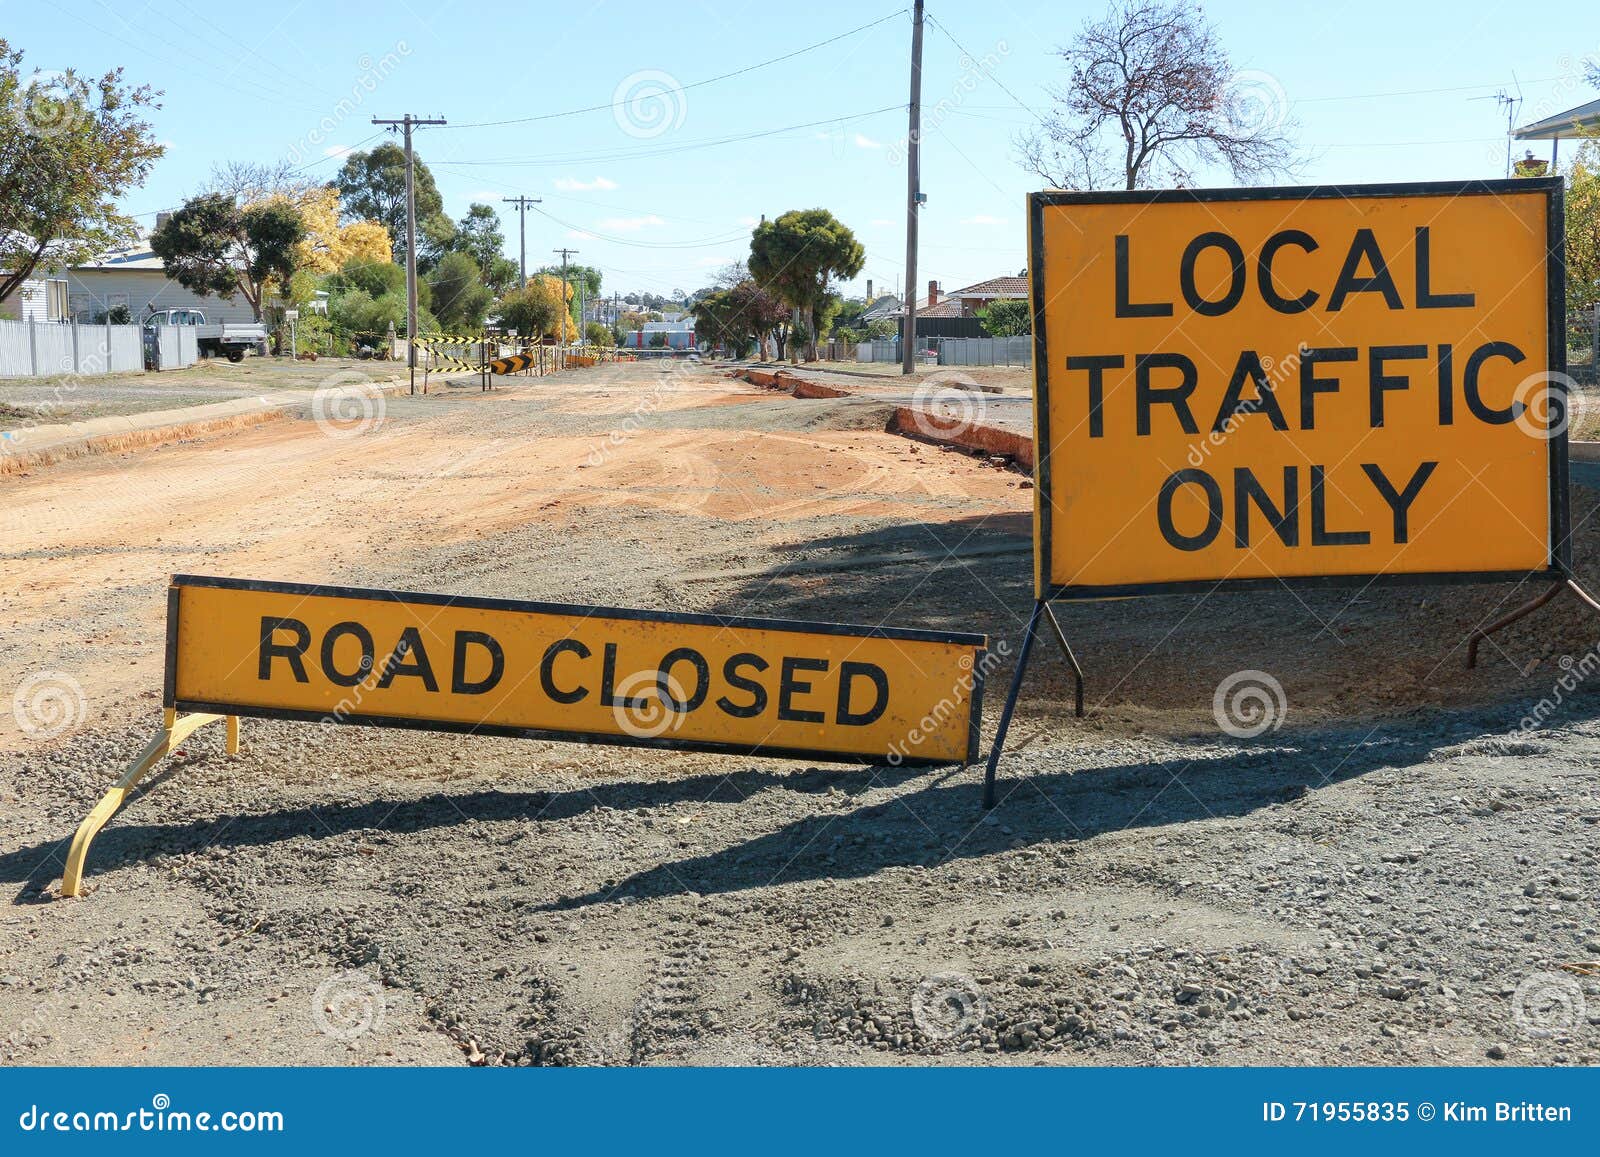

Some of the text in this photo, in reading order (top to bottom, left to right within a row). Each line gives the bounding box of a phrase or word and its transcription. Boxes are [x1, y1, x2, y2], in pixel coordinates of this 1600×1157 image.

[1115, 227, 1475, 318] LOCAL
[1066, 342, 1527, 438] TRAFFIC
[1157, 462, 1438, 551] ONLY
[258, 617, 889, 726] ROAD CLOSED
